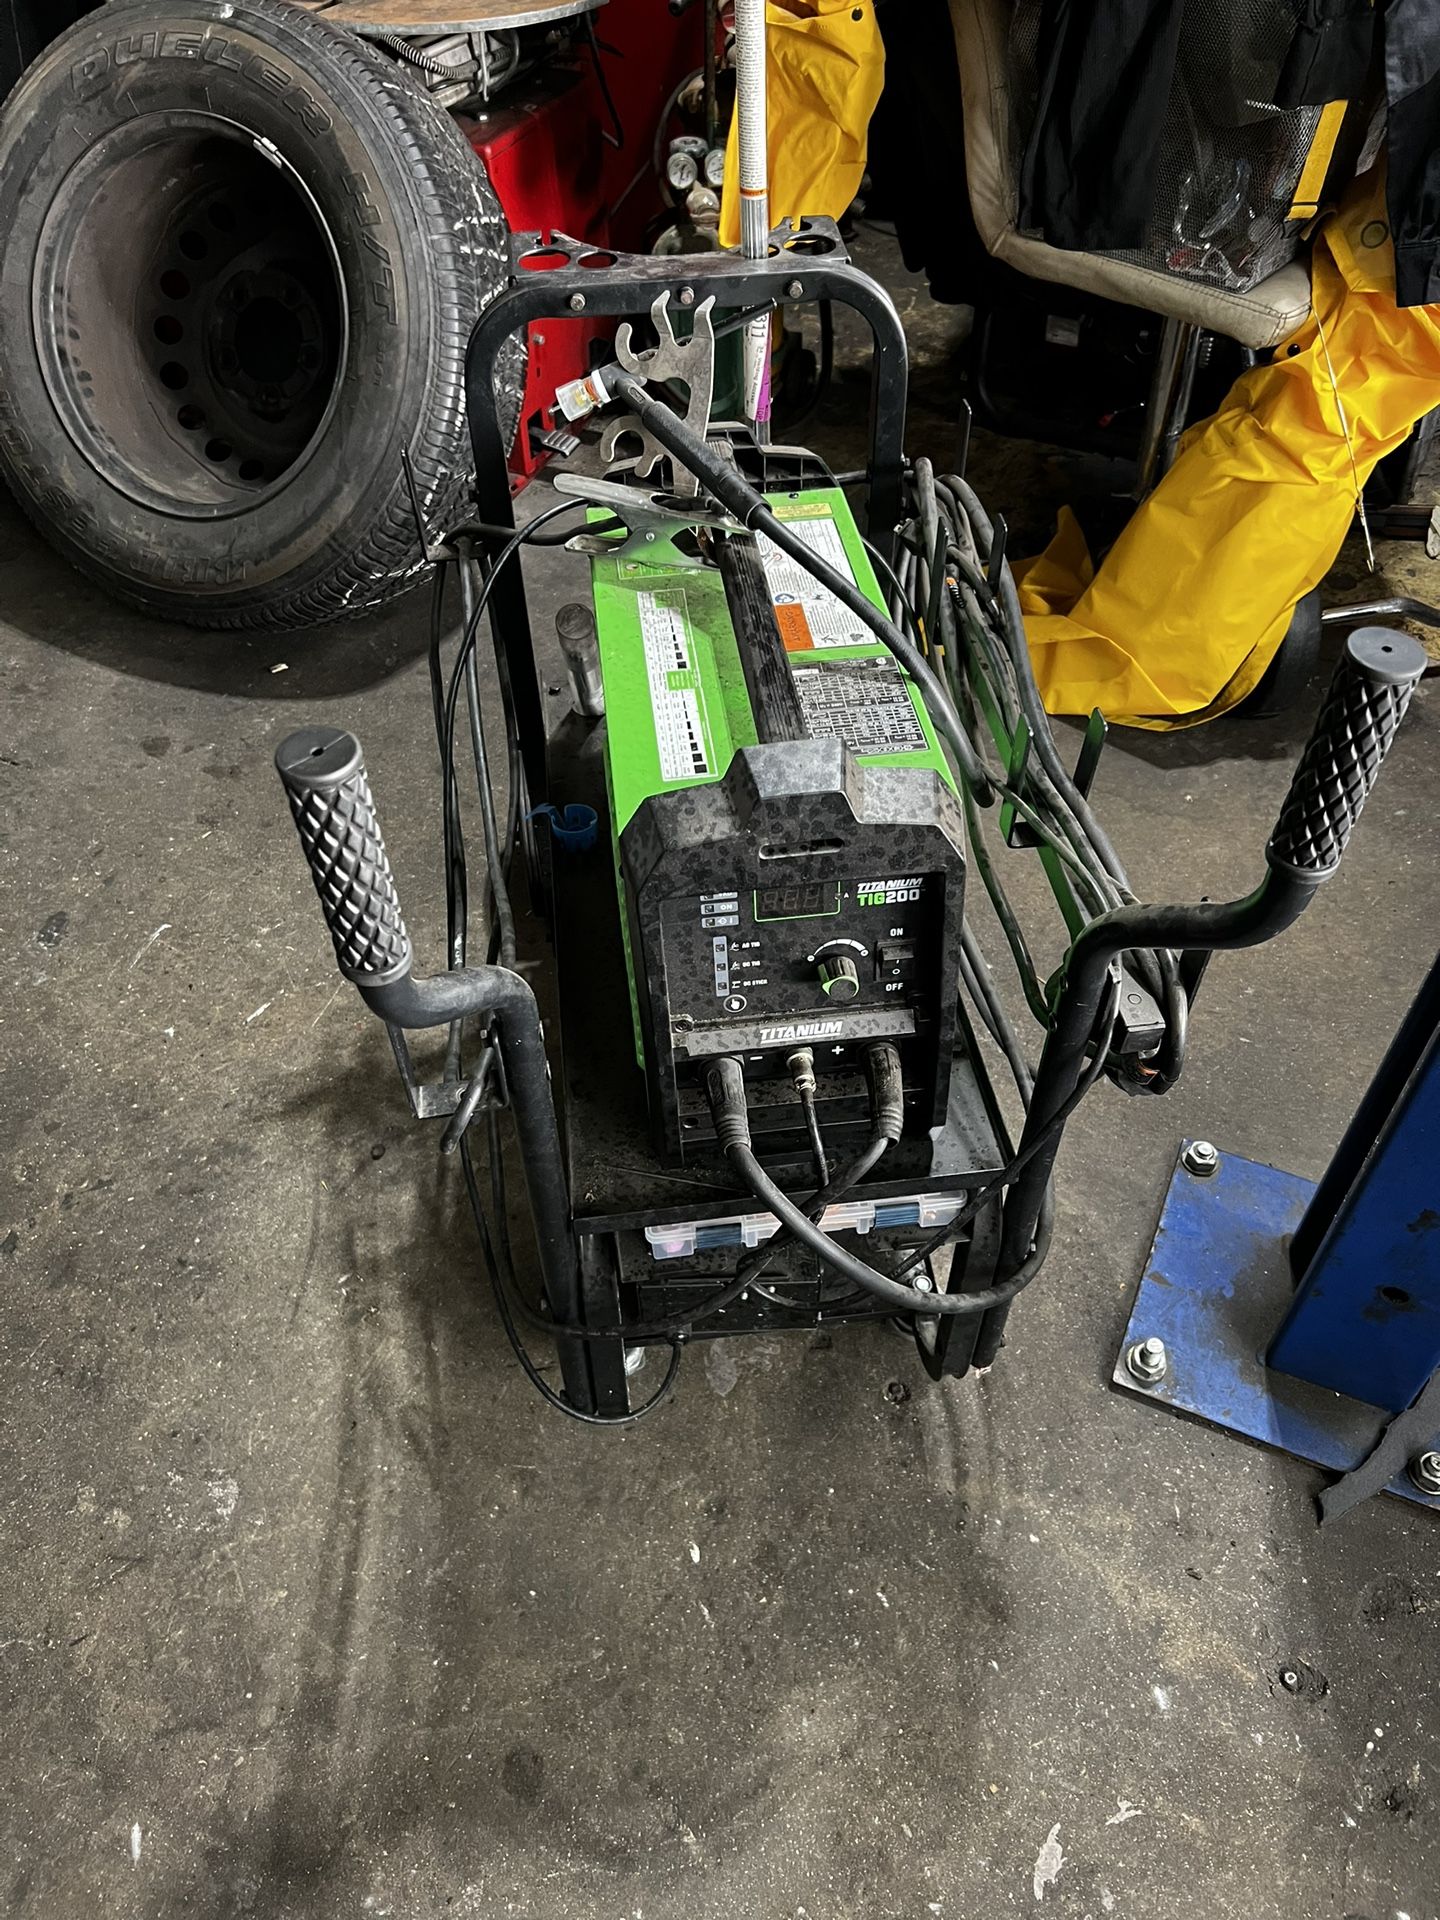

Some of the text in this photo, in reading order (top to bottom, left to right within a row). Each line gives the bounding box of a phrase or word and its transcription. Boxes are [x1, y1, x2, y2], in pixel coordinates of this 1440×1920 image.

[71, 31, 399, 325] DUELER H/T
[857, 877, 924, 894] TITANIUM
[856, 888, 921, 907] TIG200
[890, 927, 904, 937] ON
[885, 982, 904, 992] OFF
[759, 1020, 843, 1045] TITANIUM
